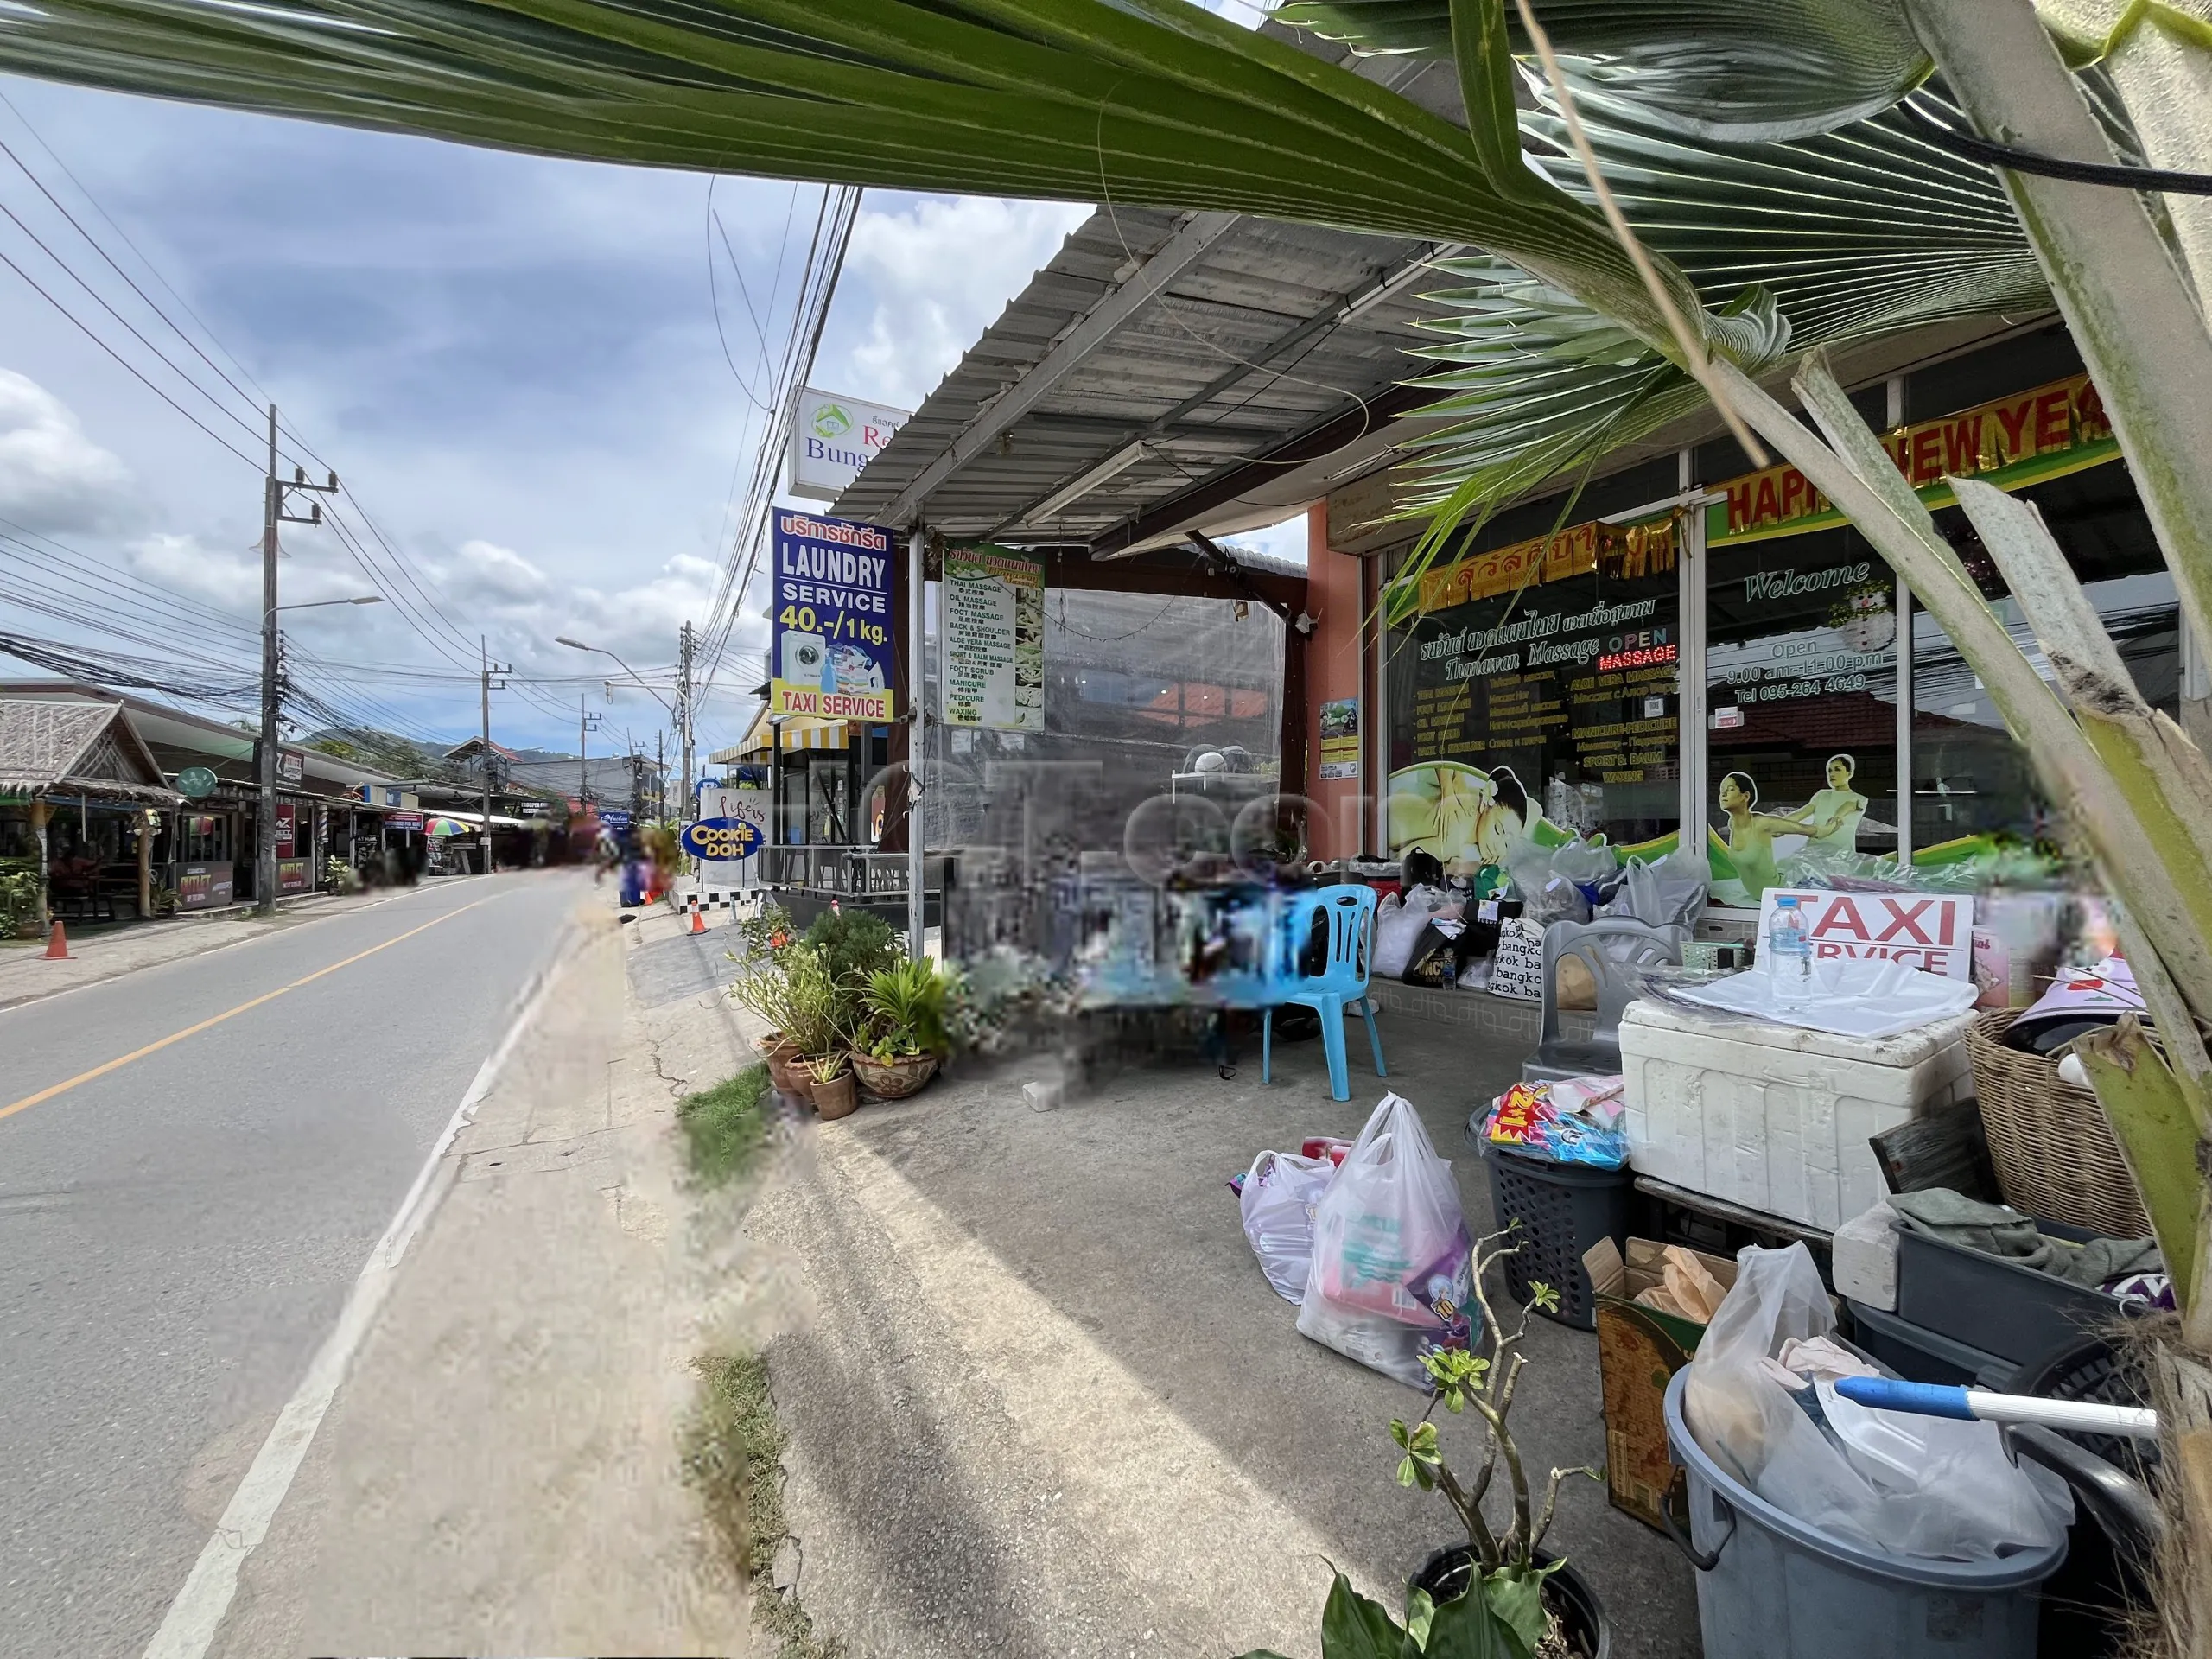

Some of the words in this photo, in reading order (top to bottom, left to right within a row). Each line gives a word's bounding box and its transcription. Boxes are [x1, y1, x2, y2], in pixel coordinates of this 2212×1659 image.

[781, 515, 887, 551] บริการซักรีด
[782, 542, 886, 588] LAUNDRY
[969, 582, 1002, 594] MASSAGE
[1744, 561, 1871, 603] Welcome
[782, 582, 886, 613] SERVICE
[964, 596, 997, 607] MASSAGE
[971, 611, 1004, 621] MASSAGE
[977, 626, 1011, 636] SHOULDER
[1609, 628, 1668, 652] OPEN
[983, 640, 1012, 650] MASSAGE
[1771, 640, 1818, 659] Open
[989, 655, 1014, 664] MASSAGE
[1445, 652, 1520, 682] Thanawan
[1526, 637, 1600, 666] Massage
[1599, 644, 1676, 671] MASSAGE
[1726, 666, 1762, 685] 9.00
[1852, 652, 1884, 671] pm
[970, 667, 995, 676] SCRUB
[1570, 677, 1595, 690] ALOE
[1598, 672, 1624, 687] VERA
[1625, 664, 1676, 683] MASSAGE
[950, 679, 986, 689] MANICURE
[1734, 689, 1758, 704] Tel
[1759, 679, 1821, 701] 095-264
[1824, 674, 1866, 692] 4649
[782, 691, 817, 713] TAXI
[823, 695, 885, 718] SERVICE
[950, 694, 985, 703] PEDICURE
[1583, 754, 1617, 768] SPORT
[1618, 753, 1627, 766] &
[1630, 751, 1663, 766] BALM
[1602, 770, 1644, 784] WAXING
[706, 843, 745, 857] DOH
[1773, 893, 1956, 946] TAXI
[1808, 942, 1949, 977] RVICE
[1499, 1090, 1535, 1127] 2+1
[1435, 1299, 1454, 1319] 10
